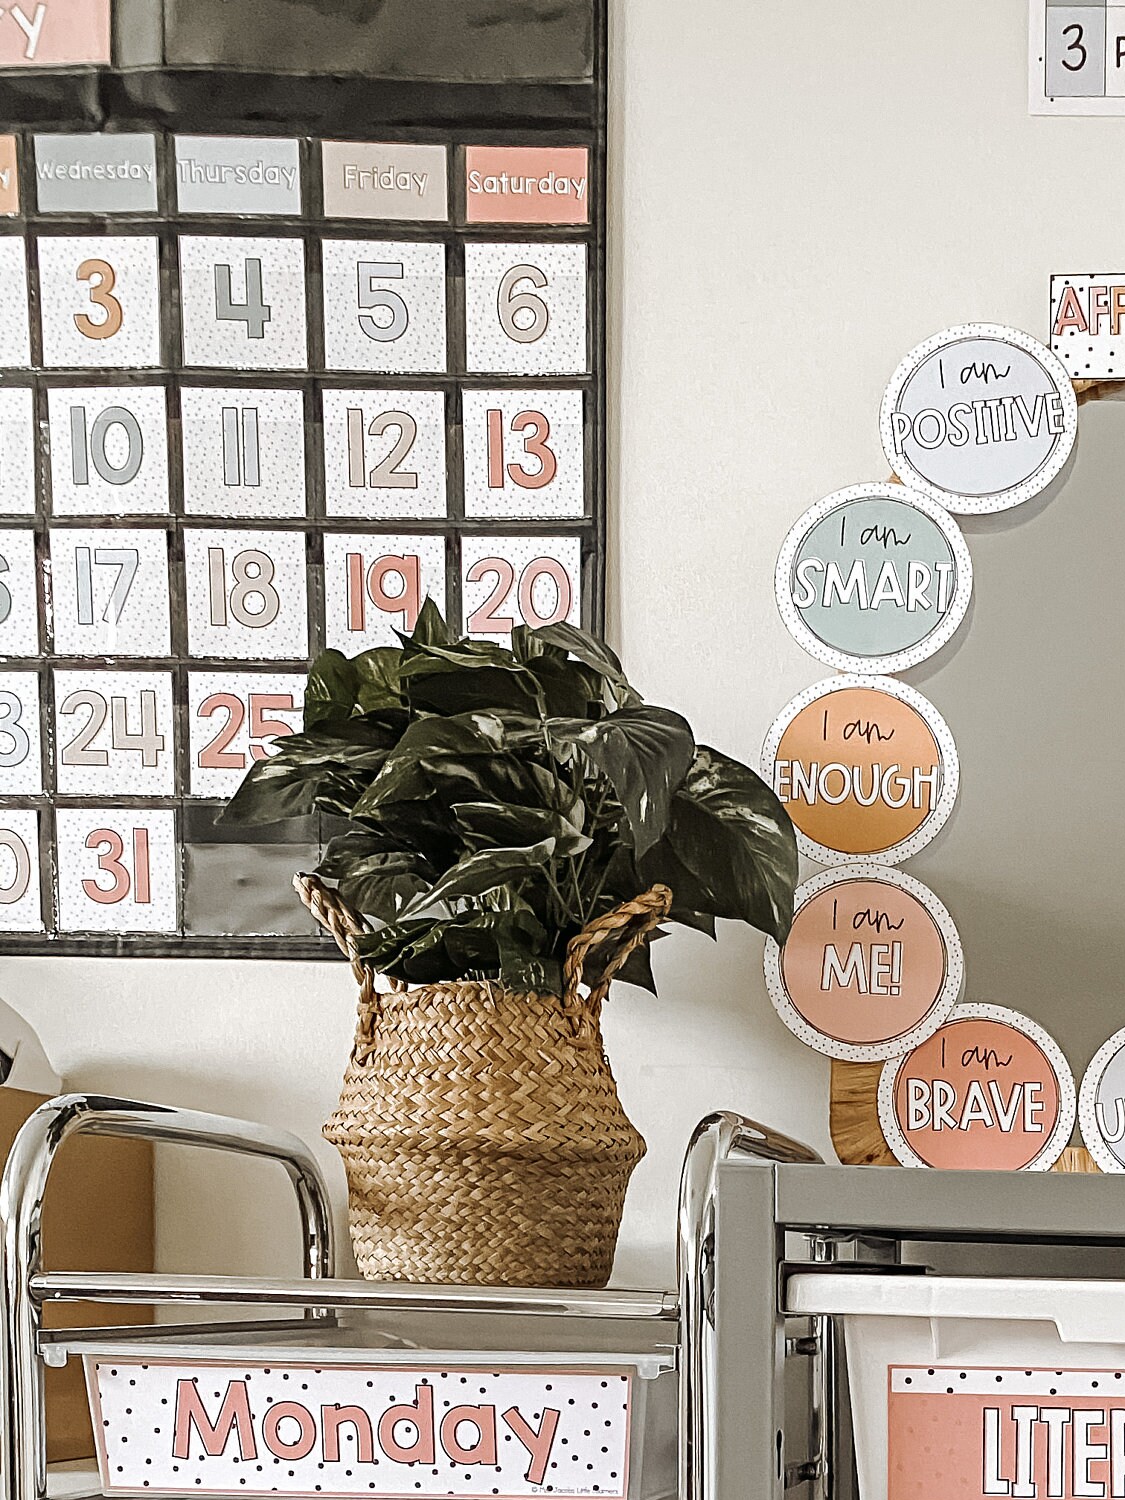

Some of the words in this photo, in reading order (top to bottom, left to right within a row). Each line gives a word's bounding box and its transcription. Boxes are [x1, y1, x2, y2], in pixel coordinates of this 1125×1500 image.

[0, 3, 46, 60] Y
[1061, 23, 1088, 71] 3
[37, 160, 153, 183] Wednesday
[177, 159, 296, 188] Thursday
[344, 166, 428, 196] Friday
[468, 171, 587, 199] Saturday
[73, 259, 123, 340] 3
[214, 258, 271, 339] 4
[357, 261, 408, 342] 5
[497, 263, 549, 343] 6
[938, 359, 945, 389] I
[960, 362, 1011, 385] am
[69, 406, 143, 486] 10
[222, 406, 261, 487] 11
[347, 408, 418, 489] 12
[486, 409, 557, 489] 13
[890, 392, 1066, 455] POSITIVE
[840, 516, 846, 547] I
[860, 521, 912, 549] am
[75, 546, 139, 625] 17
[208, 547, 279, 628] 18
[346, 553, 421, 632] 19
[466, 556, 572, 634] 20
[791, 557, 955, 614] SMART
[59, 689, 164, 767] 24
[197, 691, 295, 769] 25
[822, 710, 828, 740] I
[842, 716, 895, 744] am
[773, 759, 939, 811] ENOUGH
[82, 828, 151, 904] 31
[832, 899, 838, 930] I
[852, 905, 905, 934] am
[820, 941, 902, 996] ME!
[940, 1038, 946, 1068] I
[961, 1044, 1013, 1070] am
[906, 1077, 1044, 1134] BRAVE
[172, 1379, 561, 1486] Monday
